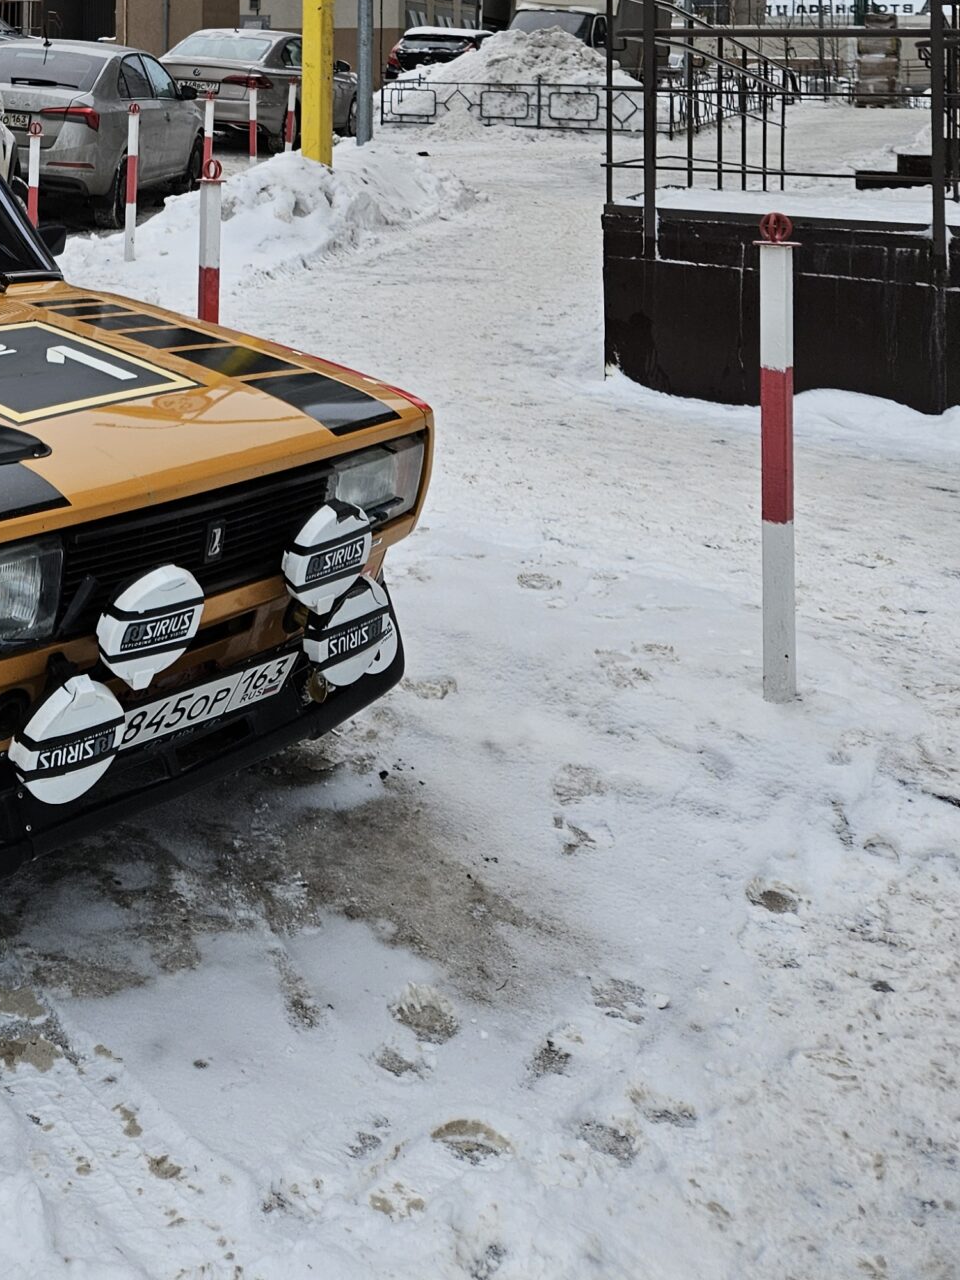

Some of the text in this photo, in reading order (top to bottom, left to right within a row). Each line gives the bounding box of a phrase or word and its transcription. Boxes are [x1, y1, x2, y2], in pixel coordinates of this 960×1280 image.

[11, 114, 27, 123] 163
[46, 345, 138, 380] 1
[323, 541, 364, 569] SIRIUS
[143, 611, 193, 639] SIRIUS
[329, 626, 368, 657] SIRIUS
[242, 657, 289, 694] 163
[240, 687, 264, 703] RUS
[39, 740, 94, 770] SIRIUS
